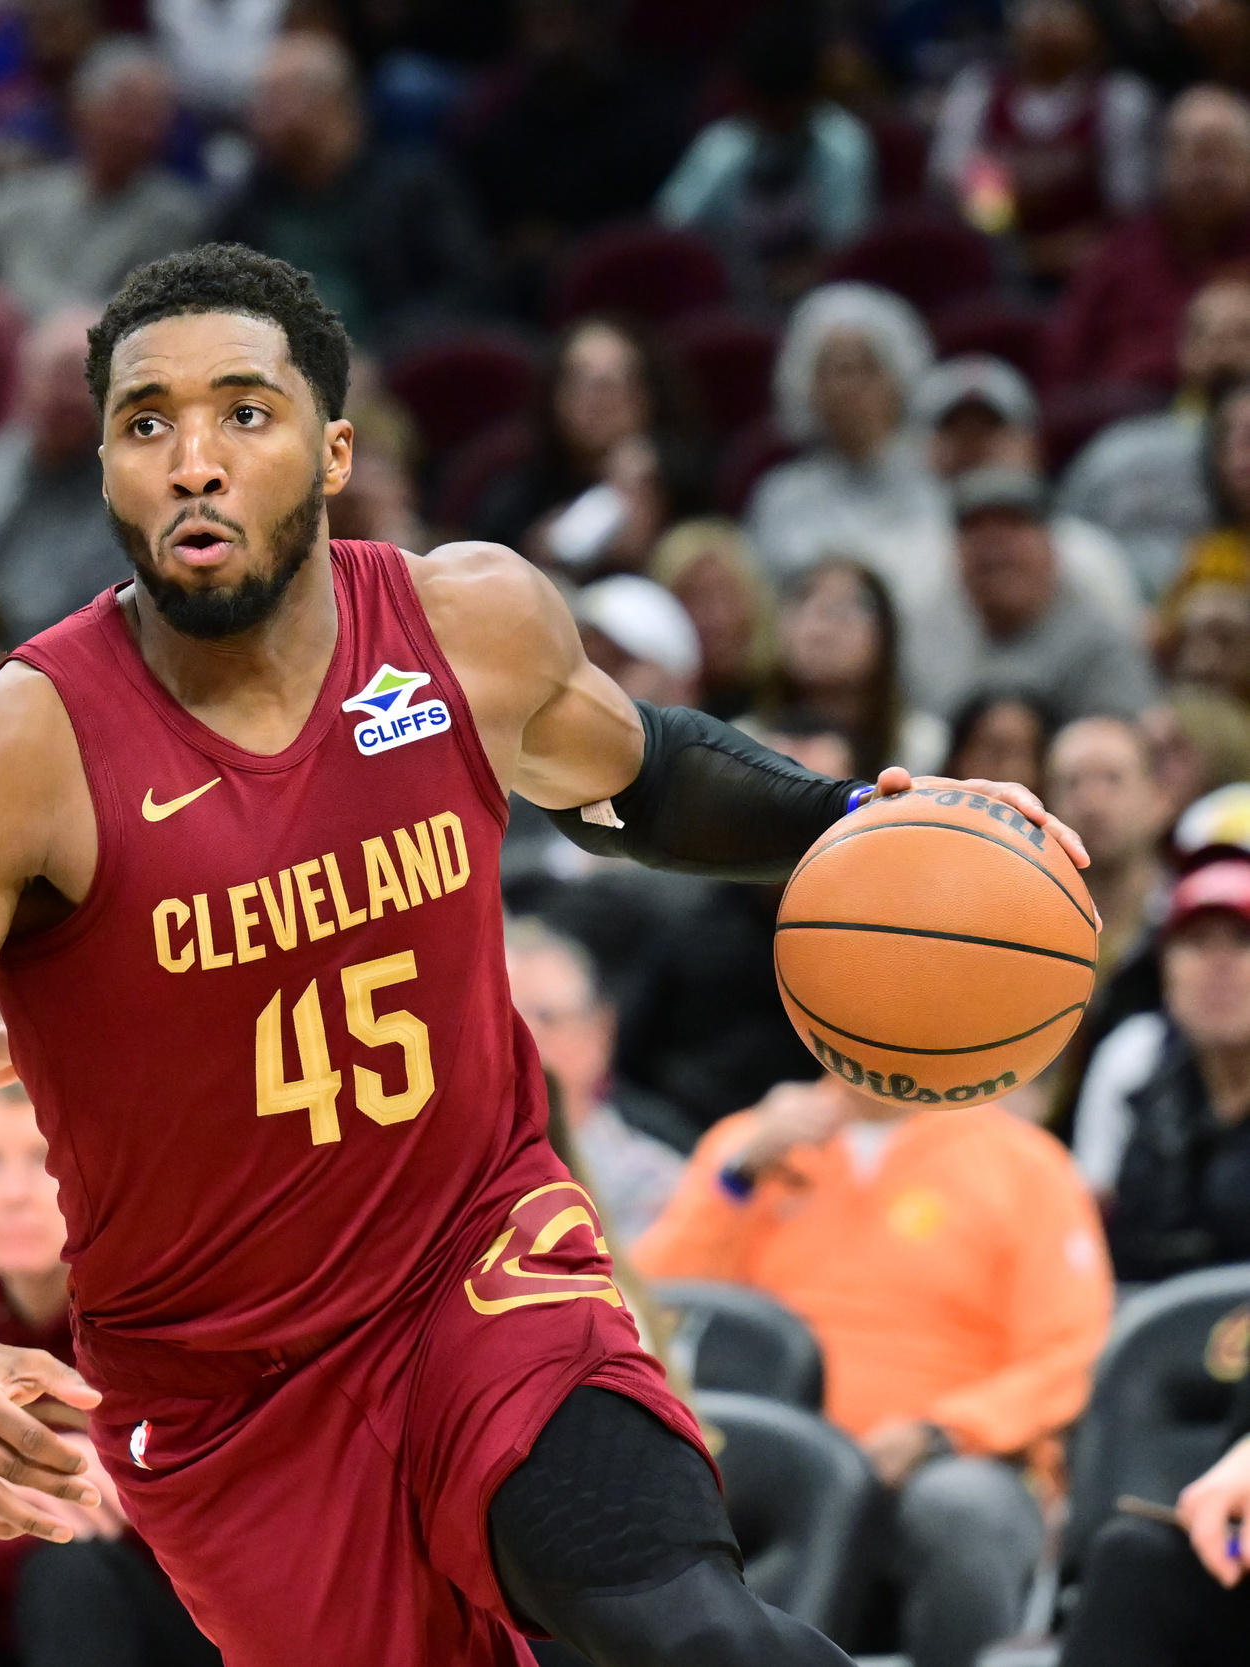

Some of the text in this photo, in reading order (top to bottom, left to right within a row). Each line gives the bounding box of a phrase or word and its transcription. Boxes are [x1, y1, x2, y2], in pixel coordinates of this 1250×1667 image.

[358, 706, 447, 748] CLIFFS
[152, 811, 471, 974] CLEVELAND
[255, 949, 436, 1146] 45
[808, 1027, 1019, 1104] Wilson
